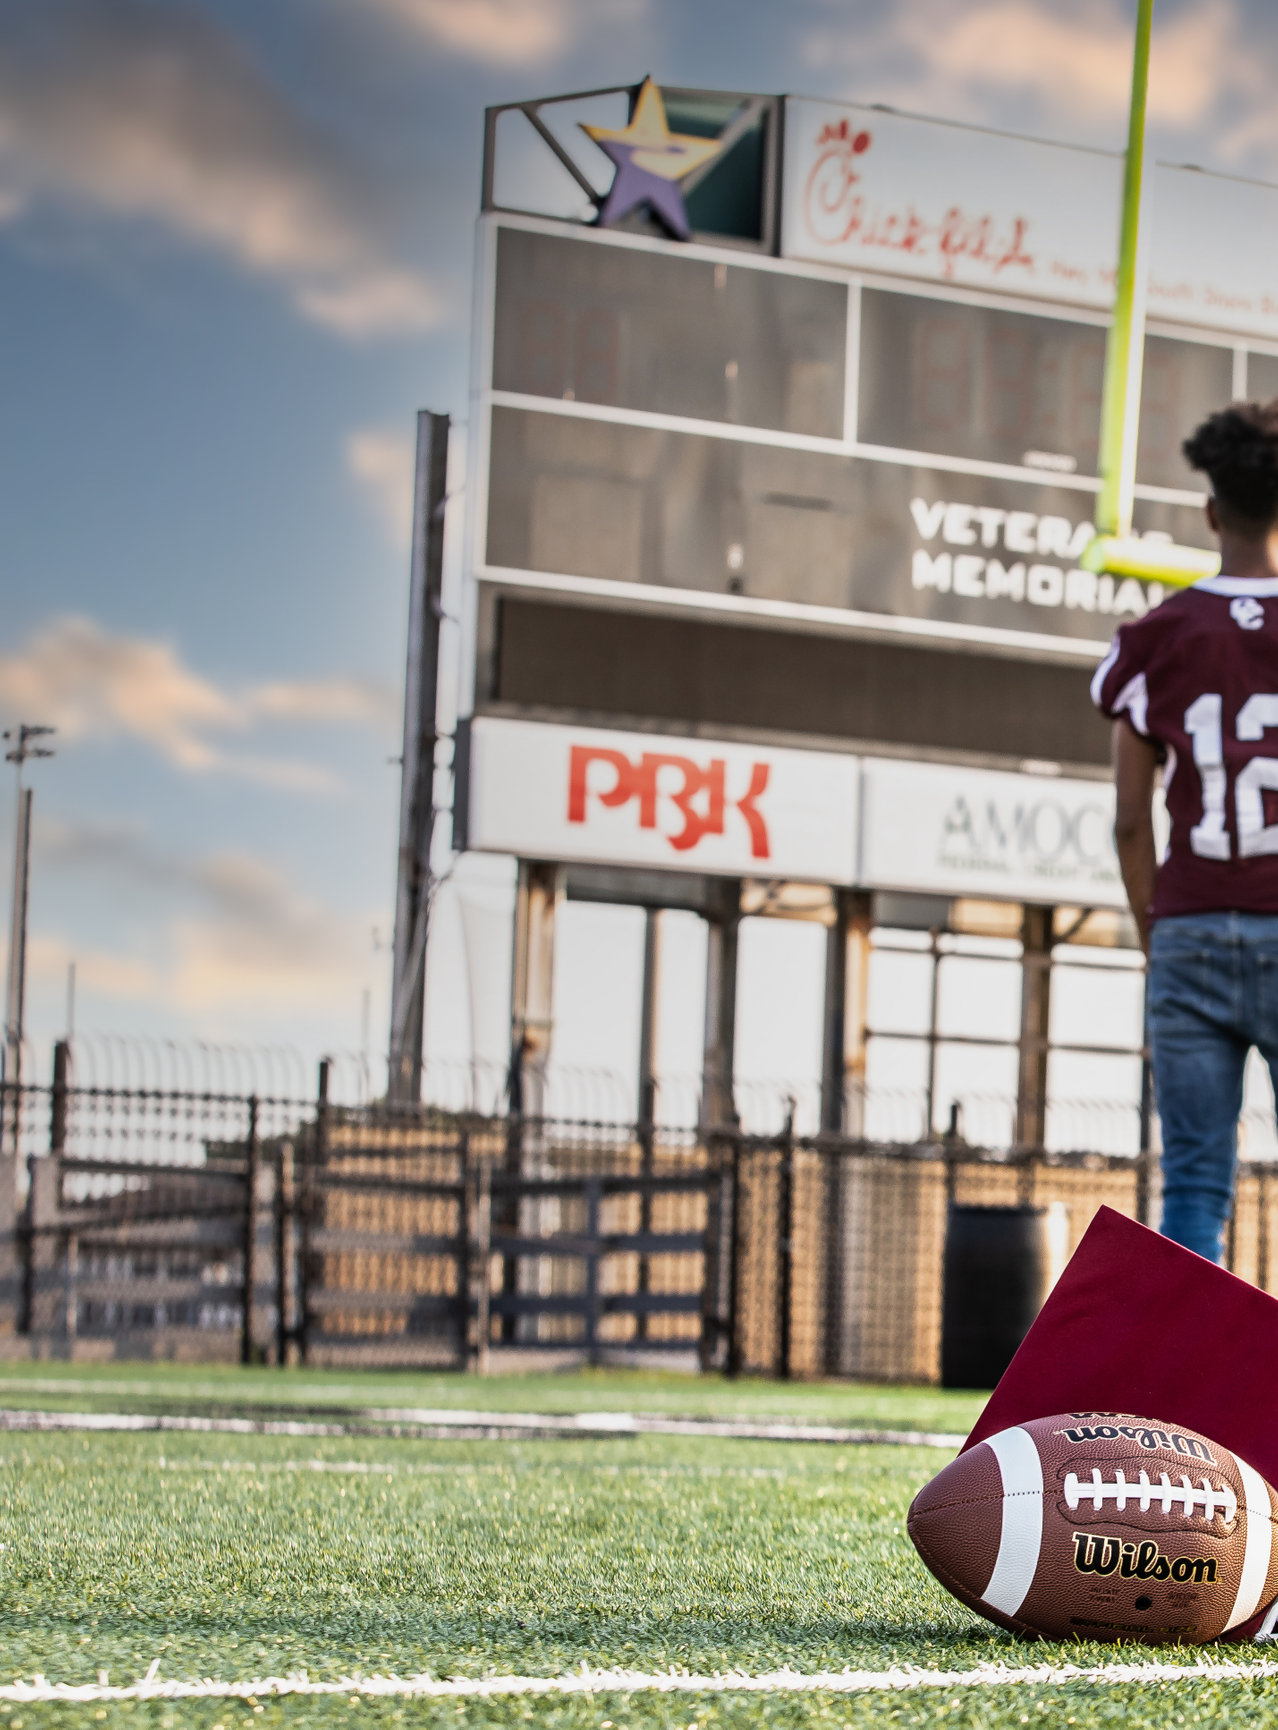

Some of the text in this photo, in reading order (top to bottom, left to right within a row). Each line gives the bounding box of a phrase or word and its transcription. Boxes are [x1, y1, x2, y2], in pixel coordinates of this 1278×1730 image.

[567, 744, 771, 859] PBK
[941, 796, 1116, 868] AMOC
[1060, 1424, 1217, 1467] Wilson
[1072, 1531, 1220, 1584] Wilson
